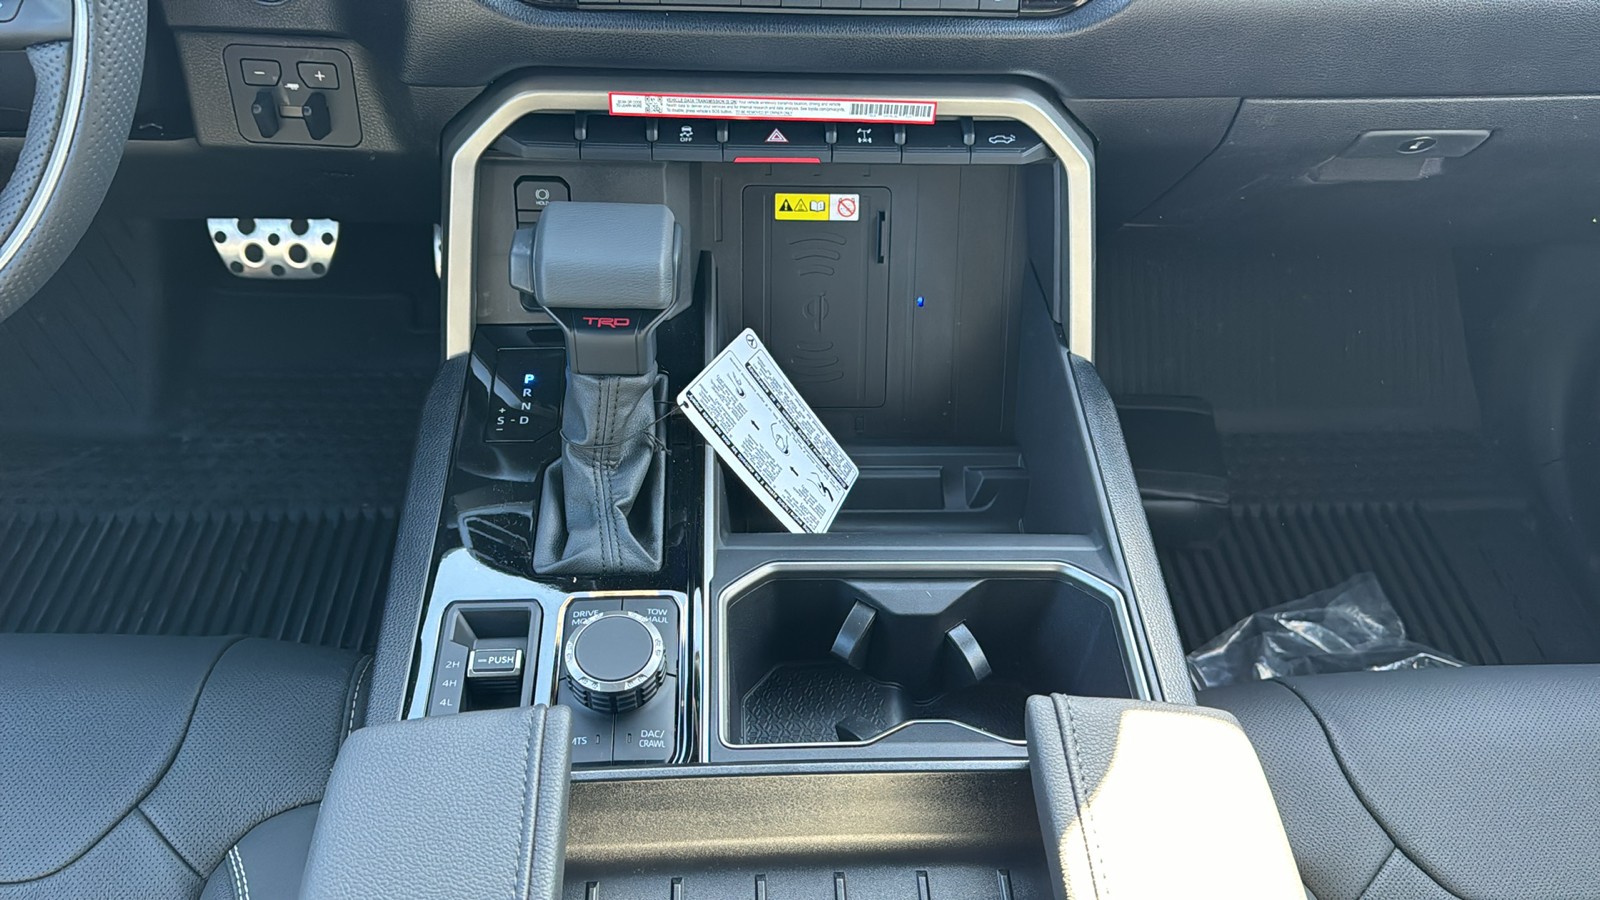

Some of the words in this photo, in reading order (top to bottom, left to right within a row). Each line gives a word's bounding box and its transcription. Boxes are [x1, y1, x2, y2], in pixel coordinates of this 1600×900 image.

[582, 316, 630, 328] TRD
[525, 373, 535, 384] P
[523, 388, 532, 397] R
[521, 402, 531, 410] N
[497, 416, 504, 425] S
[519, 416, 529, 424] D
[573, 609, 599, 618] DRIVE
[488, 656, 514, 664] PUSH
[445, 661, 460, 669] 2H
[442, 680, 457, 688] 4H
[439, 698, 453, 706] 4L
[641, 729, 665, 739] DAC/
[639, 739, 665, 748] CRAWL
